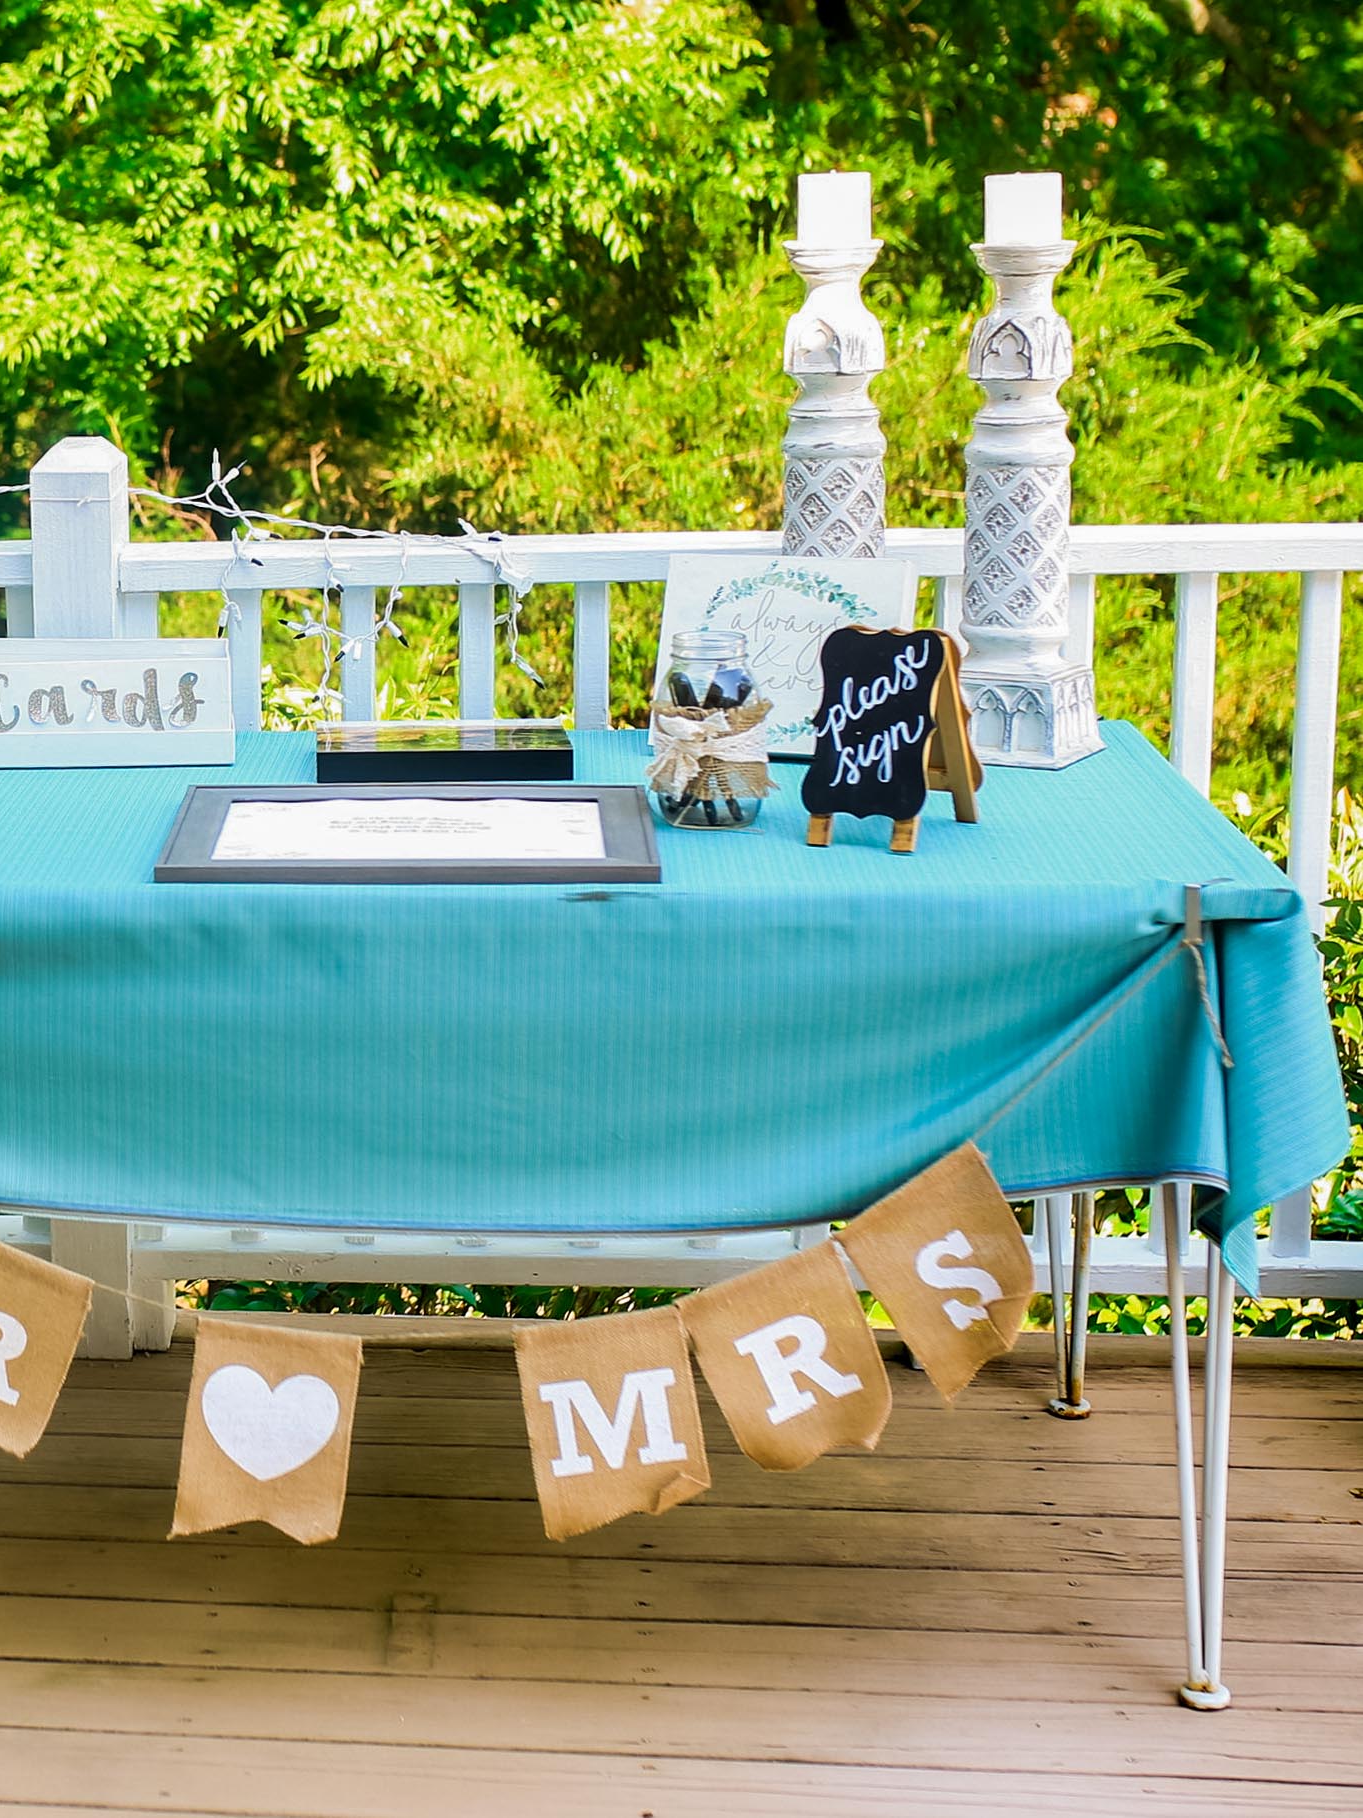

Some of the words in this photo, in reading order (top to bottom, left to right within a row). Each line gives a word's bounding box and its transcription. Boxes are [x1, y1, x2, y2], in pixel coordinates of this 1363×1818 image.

[752, 634, 790, 668] &
[812, 638, 930, 752] please
[829, 714, 925, 788] sign
